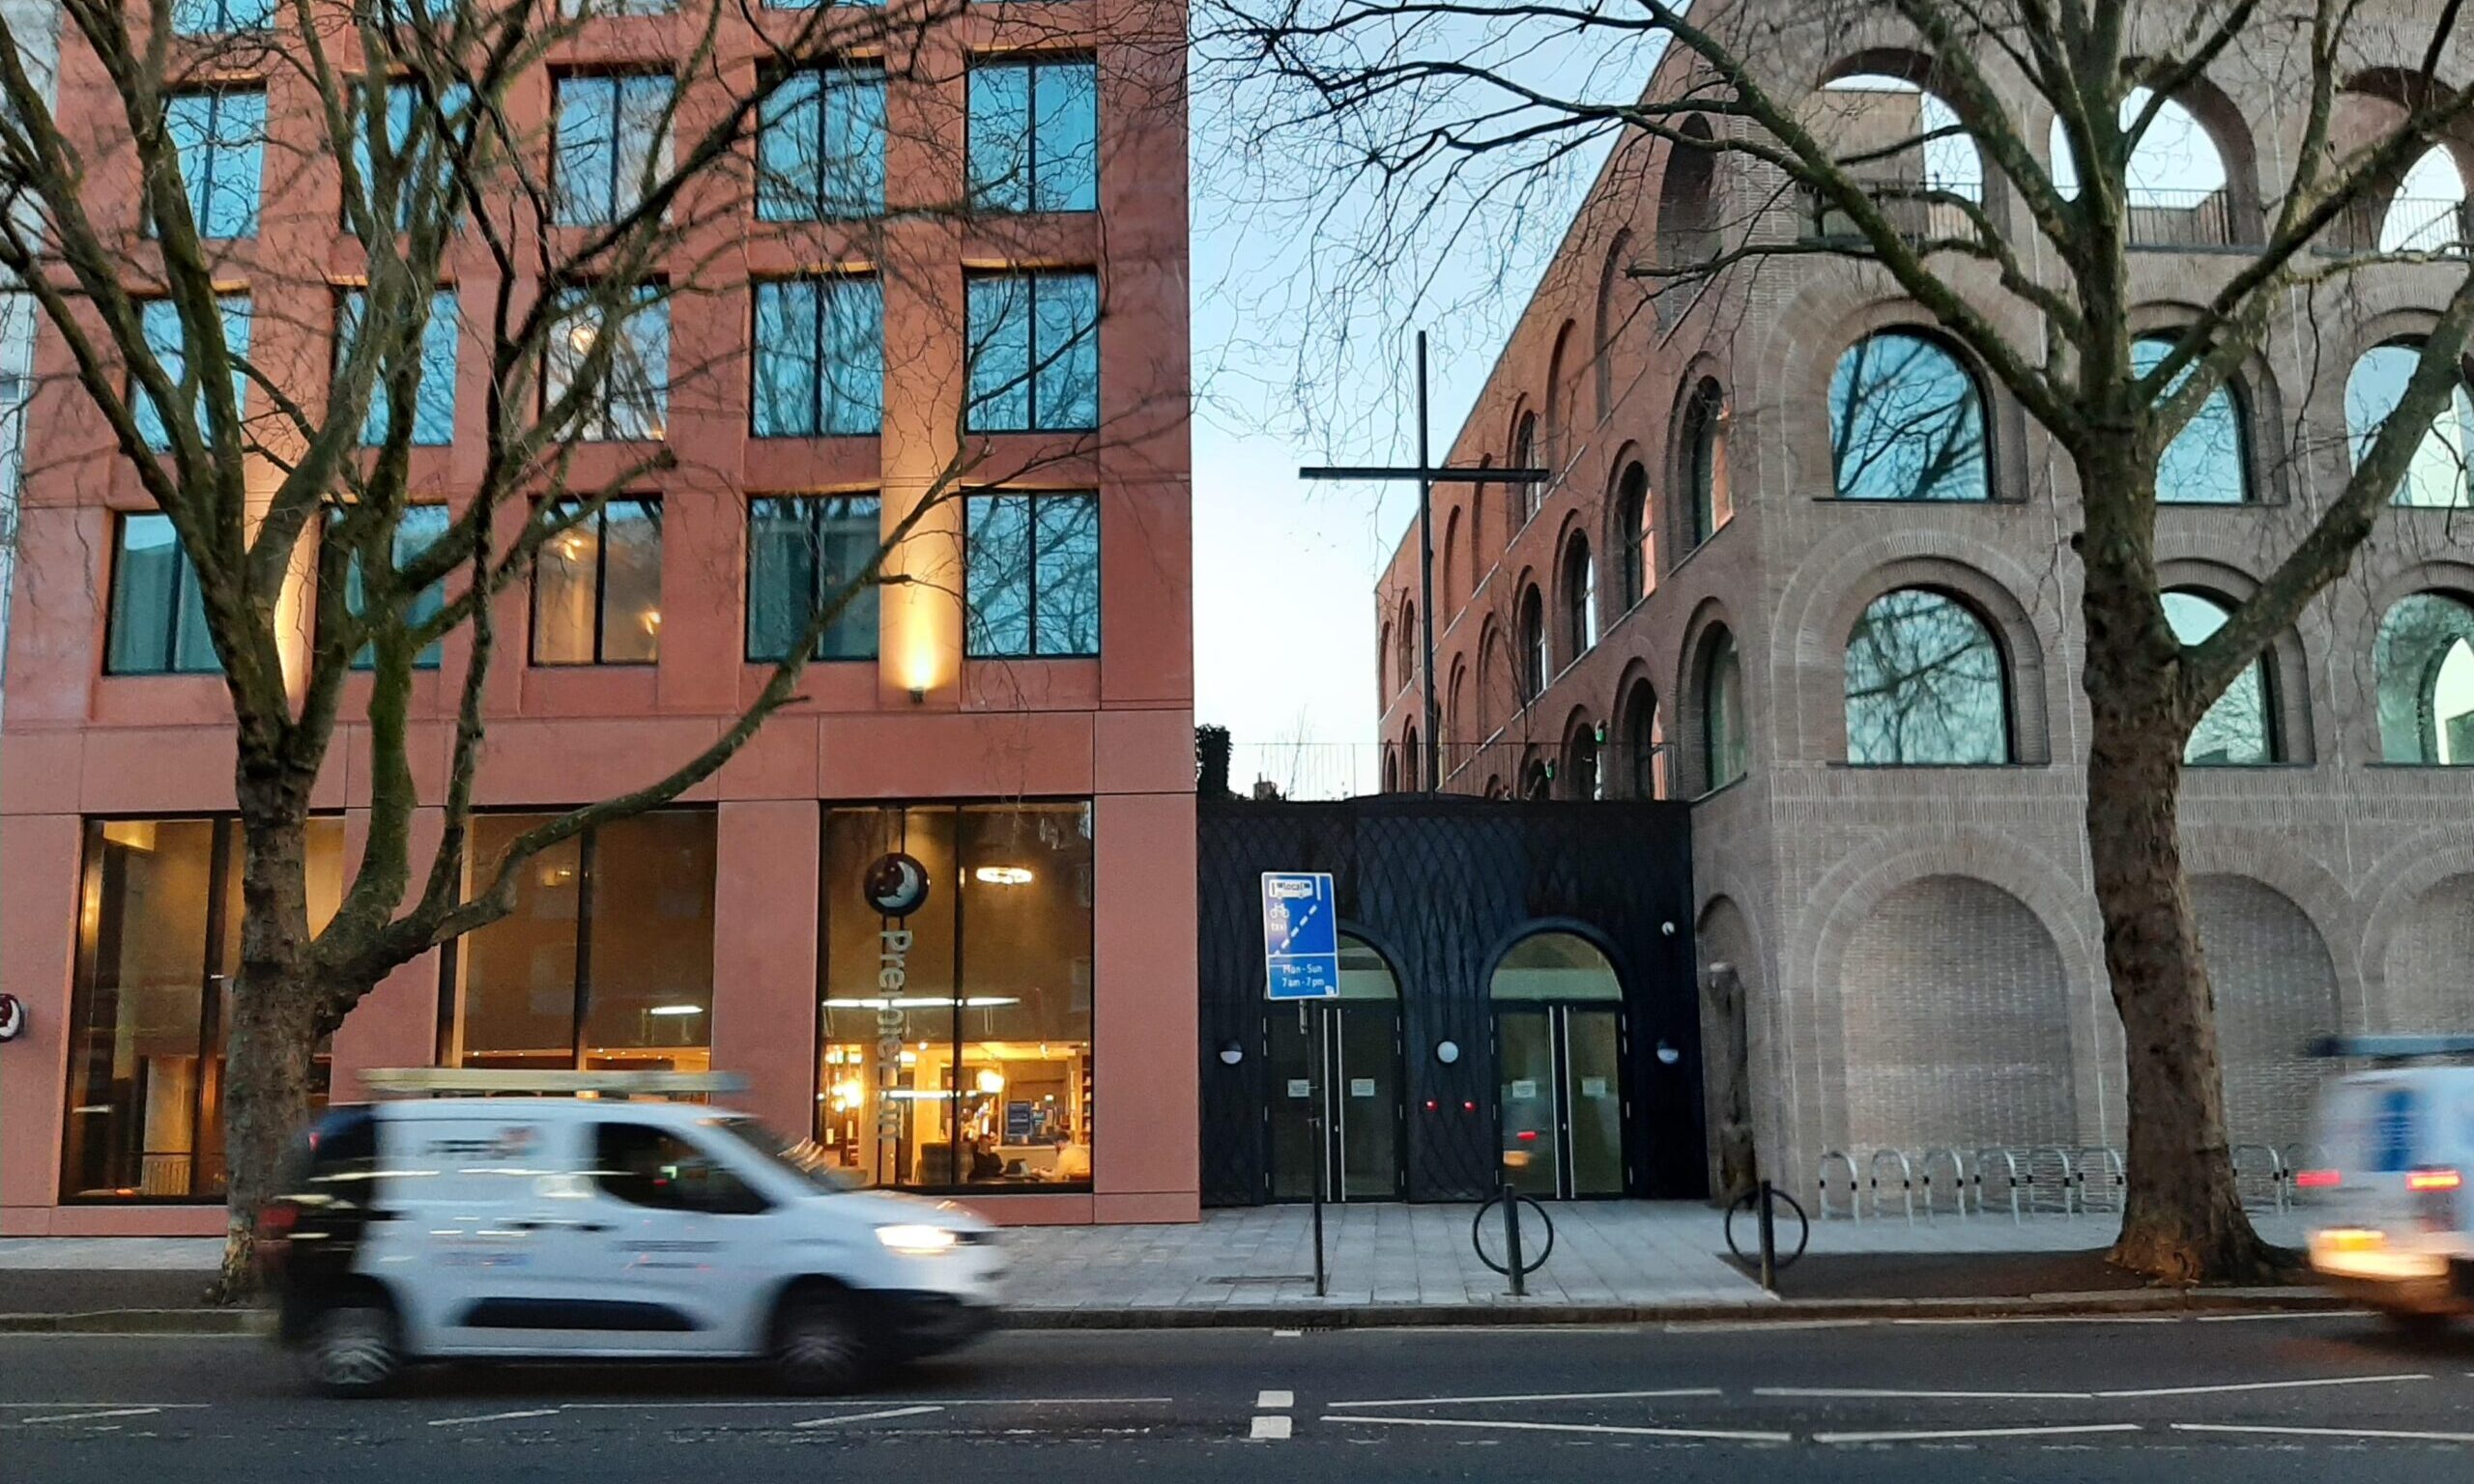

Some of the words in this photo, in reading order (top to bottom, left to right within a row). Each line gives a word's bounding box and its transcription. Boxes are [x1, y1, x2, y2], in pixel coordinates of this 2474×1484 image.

[1283, 881, 1305, 891] local
[1271, 922, 1287, 931] taxi
[1283, 963, 1301, 974] Mon
[1307, 963, 1323, 974] Sun
